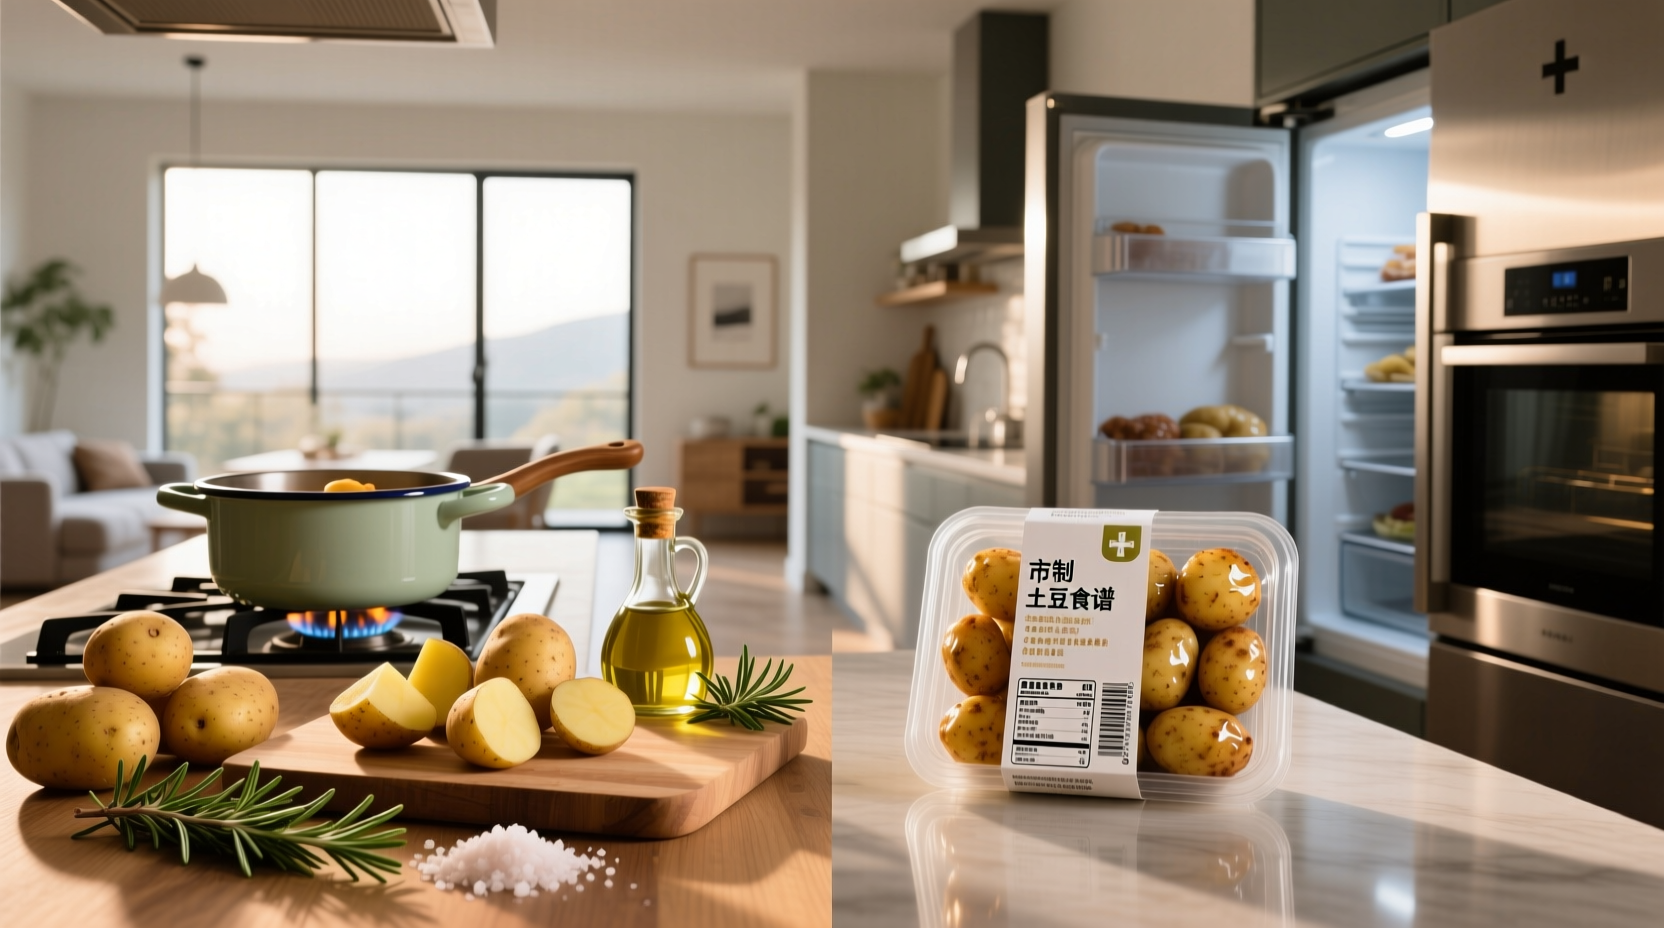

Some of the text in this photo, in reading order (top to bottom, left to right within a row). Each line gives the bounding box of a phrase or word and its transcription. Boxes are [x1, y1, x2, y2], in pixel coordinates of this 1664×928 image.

[1029, 559, 1074, 583] 市制
[1026, 586, 1115, 611] 土豆食谱
